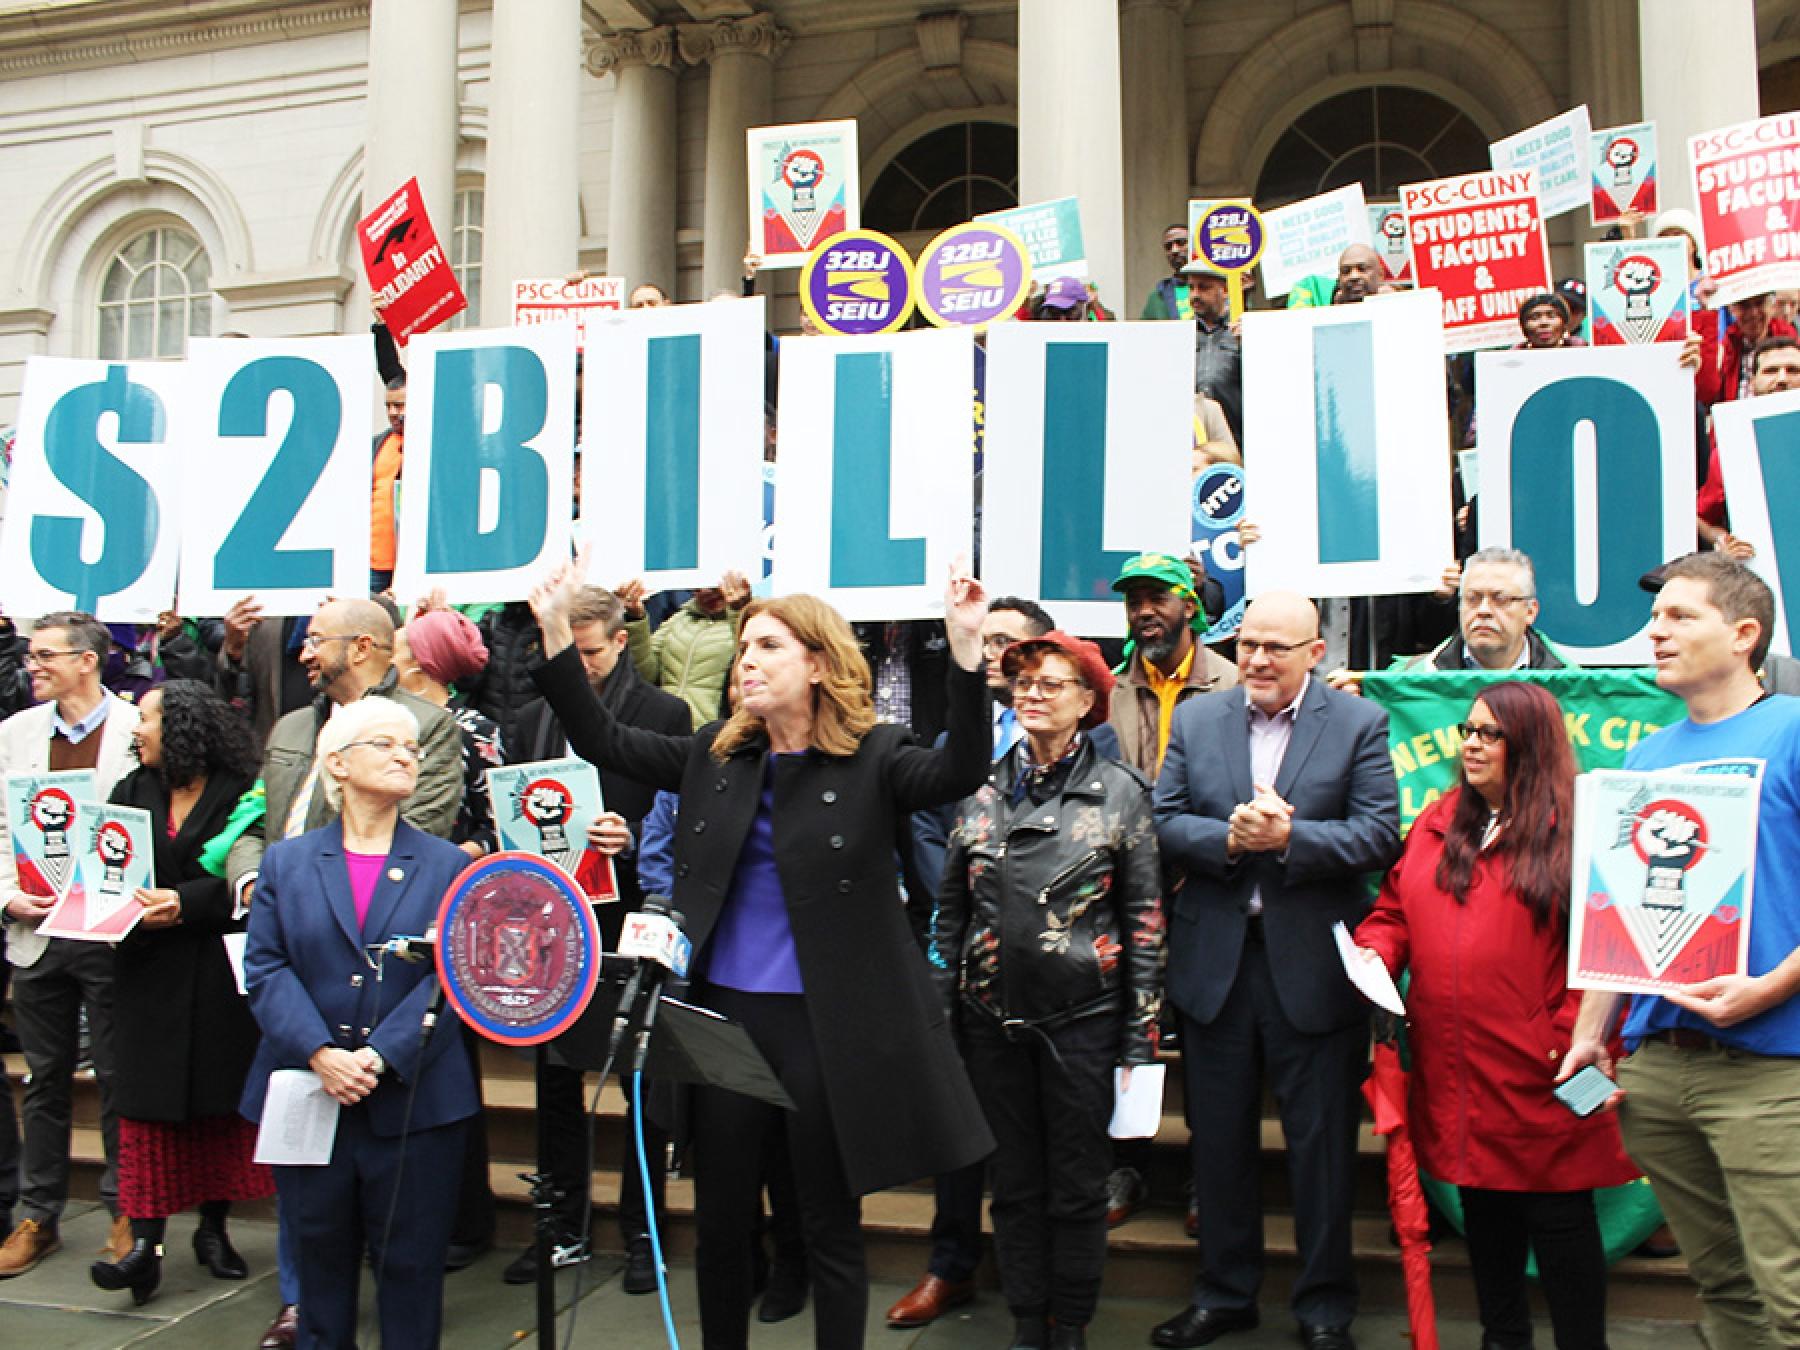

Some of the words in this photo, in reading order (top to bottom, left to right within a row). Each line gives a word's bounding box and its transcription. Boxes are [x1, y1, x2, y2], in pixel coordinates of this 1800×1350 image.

[1694, 118, 1800, 160] PSC-CU
[1700, 148, 1800, 193] STUDEN
[1405, 172, 1531, 210] PSC-CUNY
[1717, 175, 1800, 216] FACUL
[1411, 203, 1538, 245] STUDENTS,
[1766, 206, 1790, 231] &
[825, 251, 891, 271] 32BJ
[937, 239, 1005, 264] 32BJ
[1430, 233, 1529, 270] FACULTY
[1709, 236, 1767, 275] STAFF
[516, 281, 619, 300] PSC-CUNY
[1474, 265, 1496, 290] &
[825, 301, 891, 321] SEIU
[937, 287, 1005, 314] SEIU
[1445, 295, 1477, 323] AFF
[1392, 723, 1461, 780] NEW
